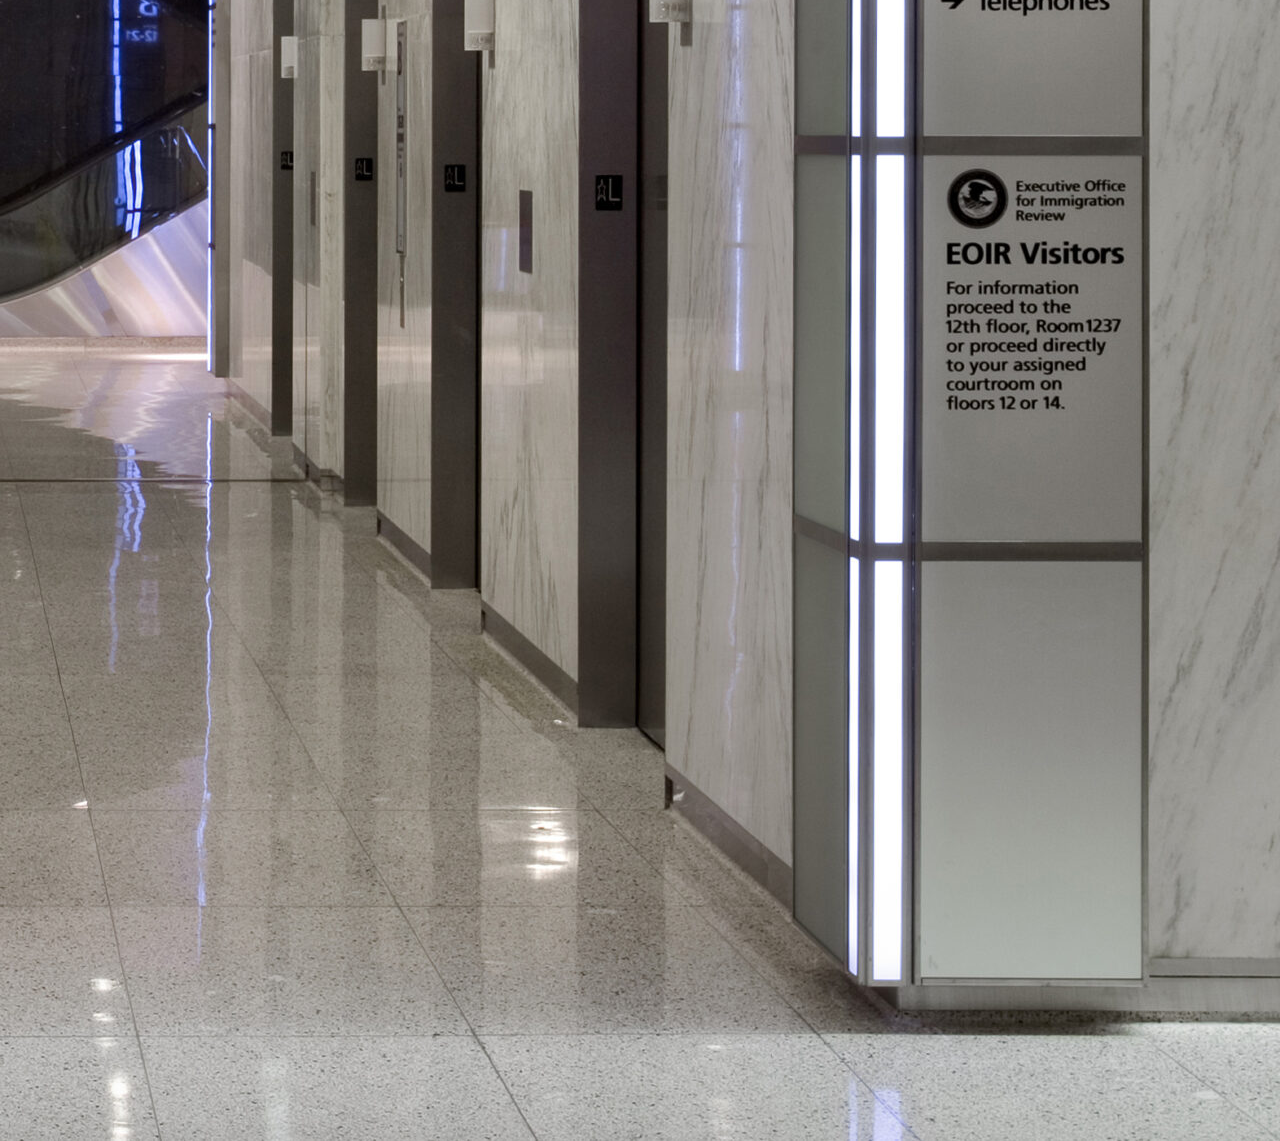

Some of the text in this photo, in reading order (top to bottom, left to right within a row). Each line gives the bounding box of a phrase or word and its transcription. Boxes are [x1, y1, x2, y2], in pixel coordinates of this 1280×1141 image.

[455, 166, 464, 185] L
[608, 178, 621, 201] L
[1015, 180, 1126, 193] Executive Office
[1015, 195, 1125, 210] for Immigration
[1015, 210, 1066, 222] Review
[946, 241, 1125, 266] EOIR Visitors
[946, 280, 1079, 295] For information
[946, 299, 1072, 318] proceed to the
[945, 319, 1122, 336] 12th floor, Room 1237
[946, 338, 1107, 357] or proceed directly
[946, 357, 1087, 376] to your assigned
[946, 378, 1063, 392] courtroom on
[946, 396, 1065, 411] floors 12 or 14.
